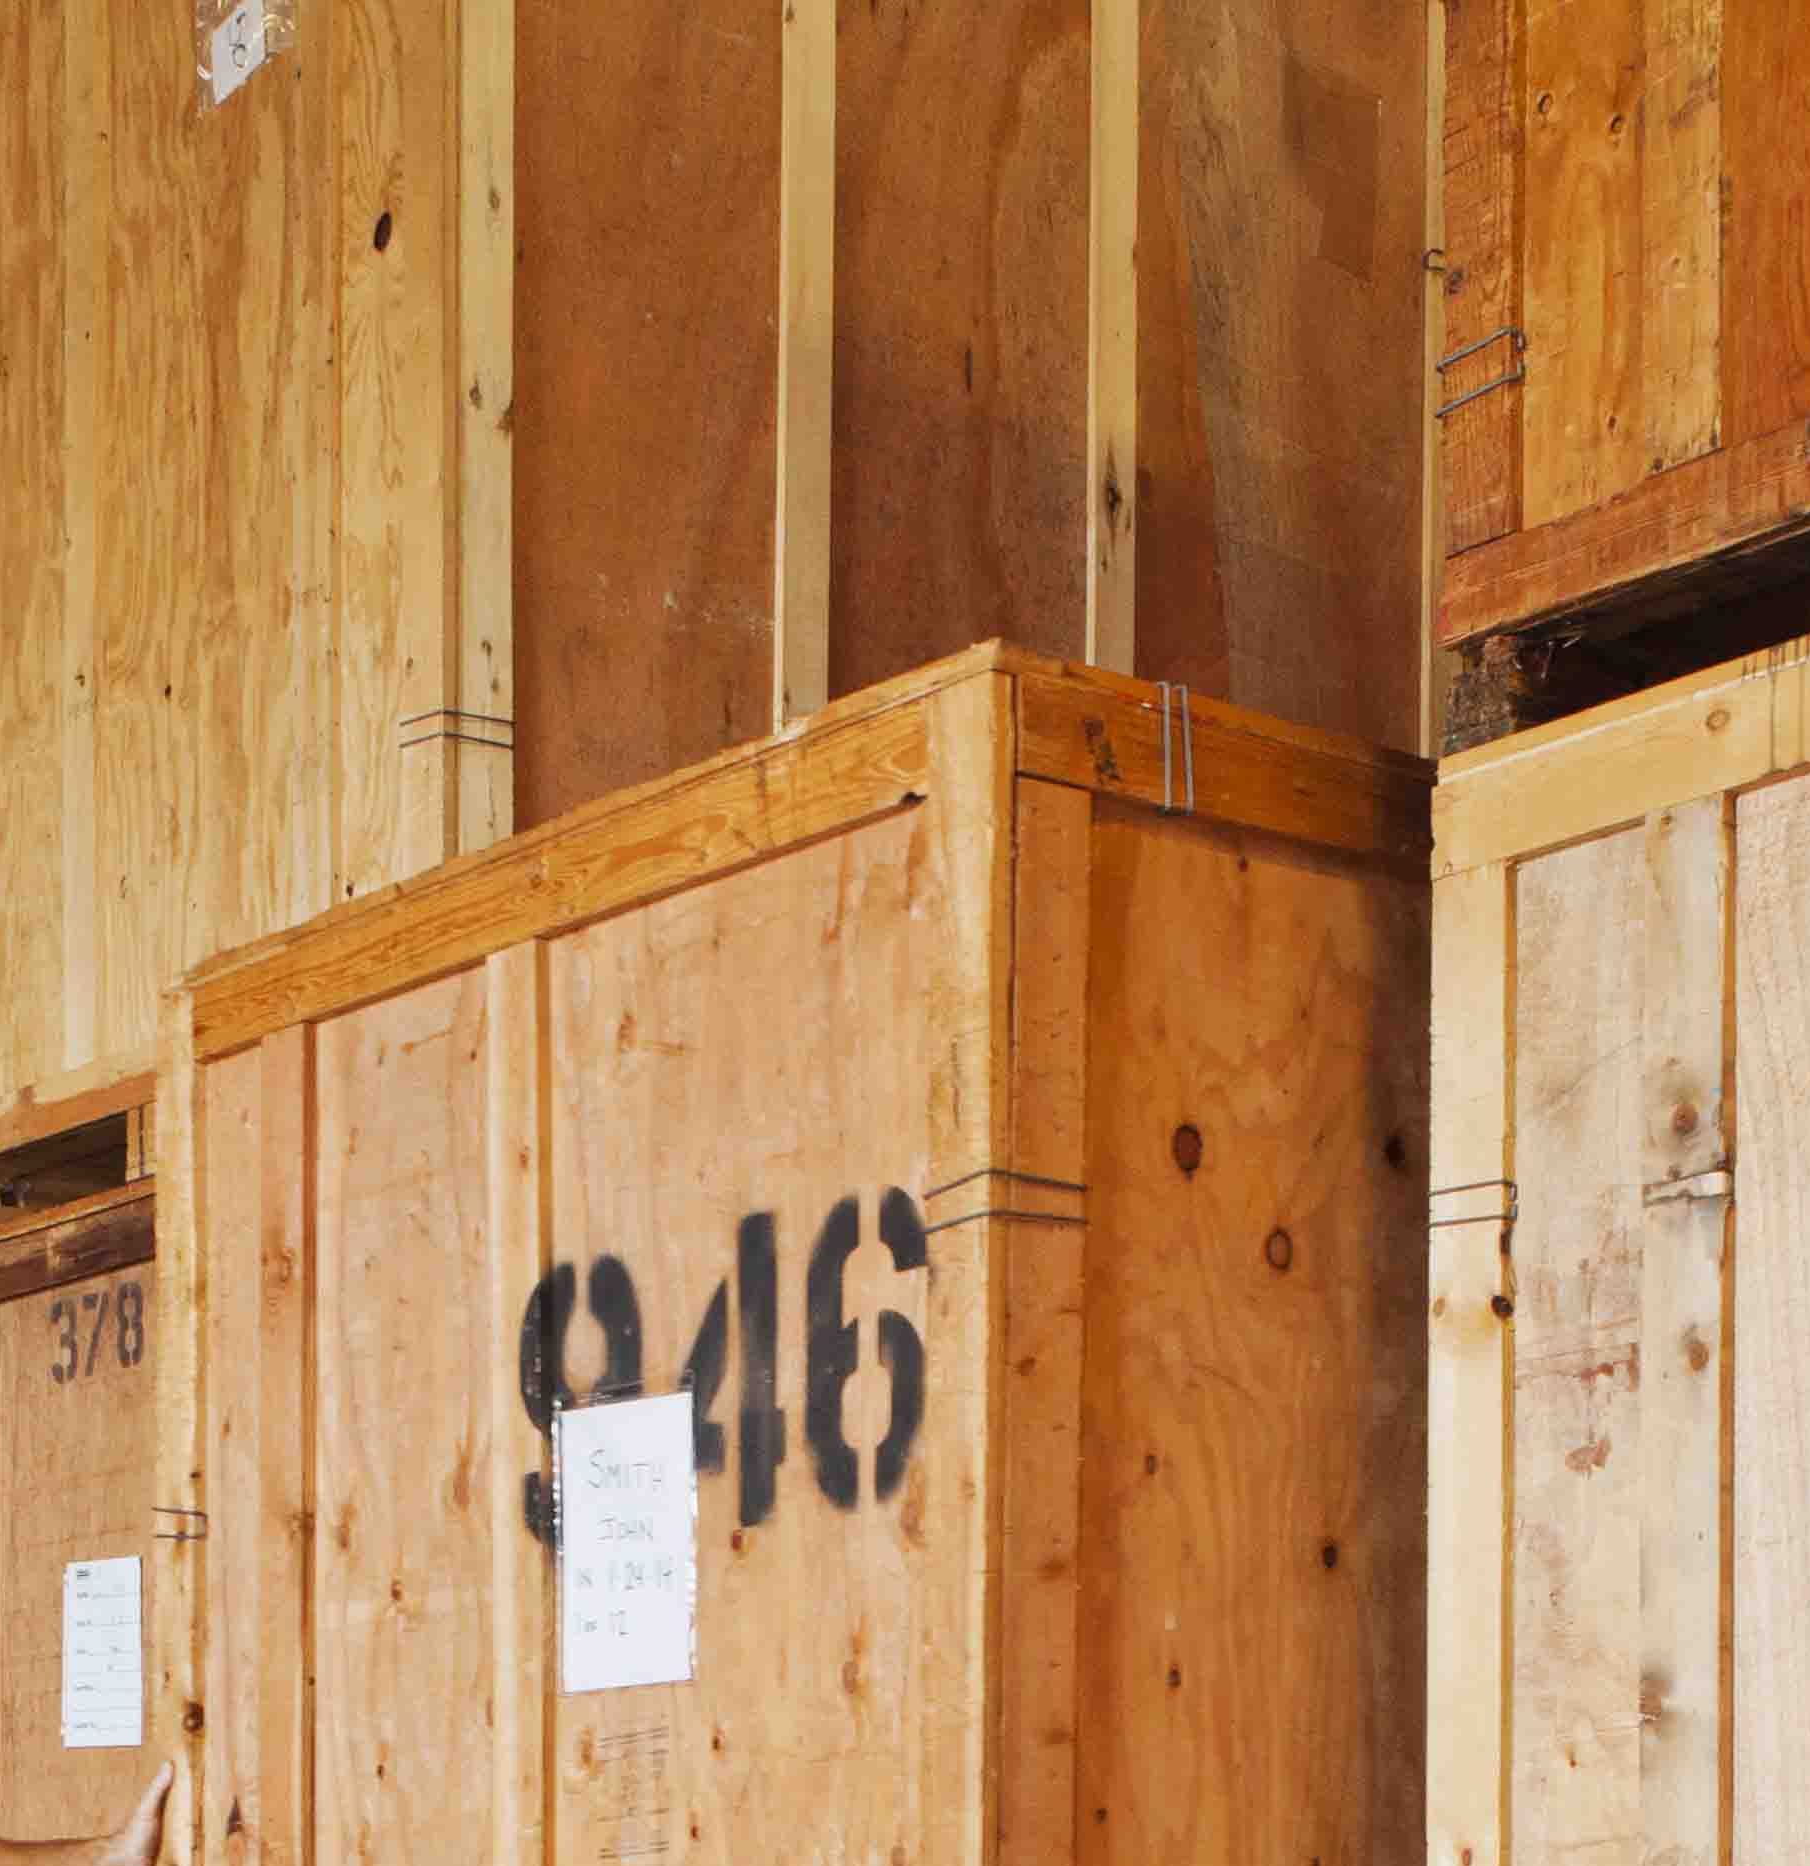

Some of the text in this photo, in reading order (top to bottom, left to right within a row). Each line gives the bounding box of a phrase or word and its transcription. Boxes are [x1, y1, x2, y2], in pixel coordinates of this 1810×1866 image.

[46, 1281, 142, 1384] 378
[520, 1186, 927, 1546] 946
[587, 1447, 665, 1491] SMITH
